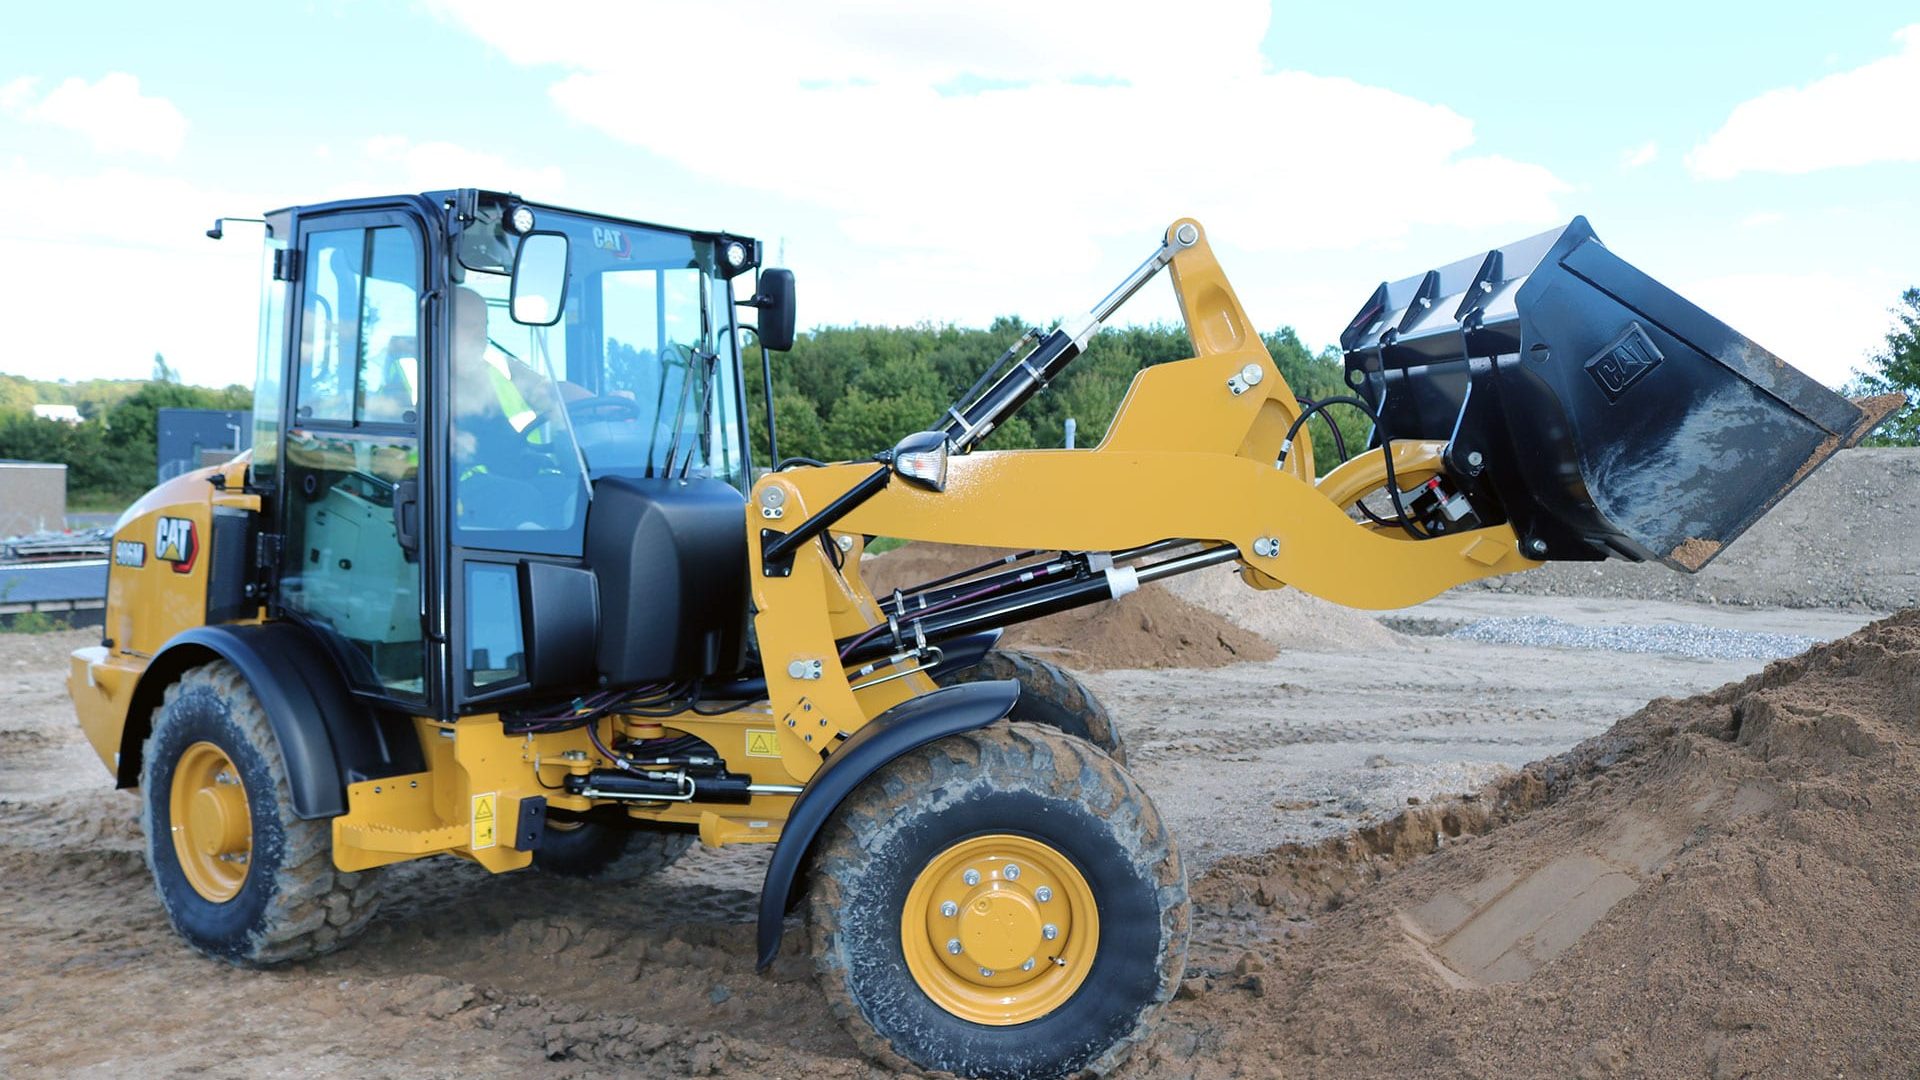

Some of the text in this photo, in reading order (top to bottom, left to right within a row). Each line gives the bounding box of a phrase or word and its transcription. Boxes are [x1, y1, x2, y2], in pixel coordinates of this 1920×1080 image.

[592, 226, 622, 252] CAT
[1594, 332, 1653, 393] CAT
[156, 517, 193, 562] CAT
